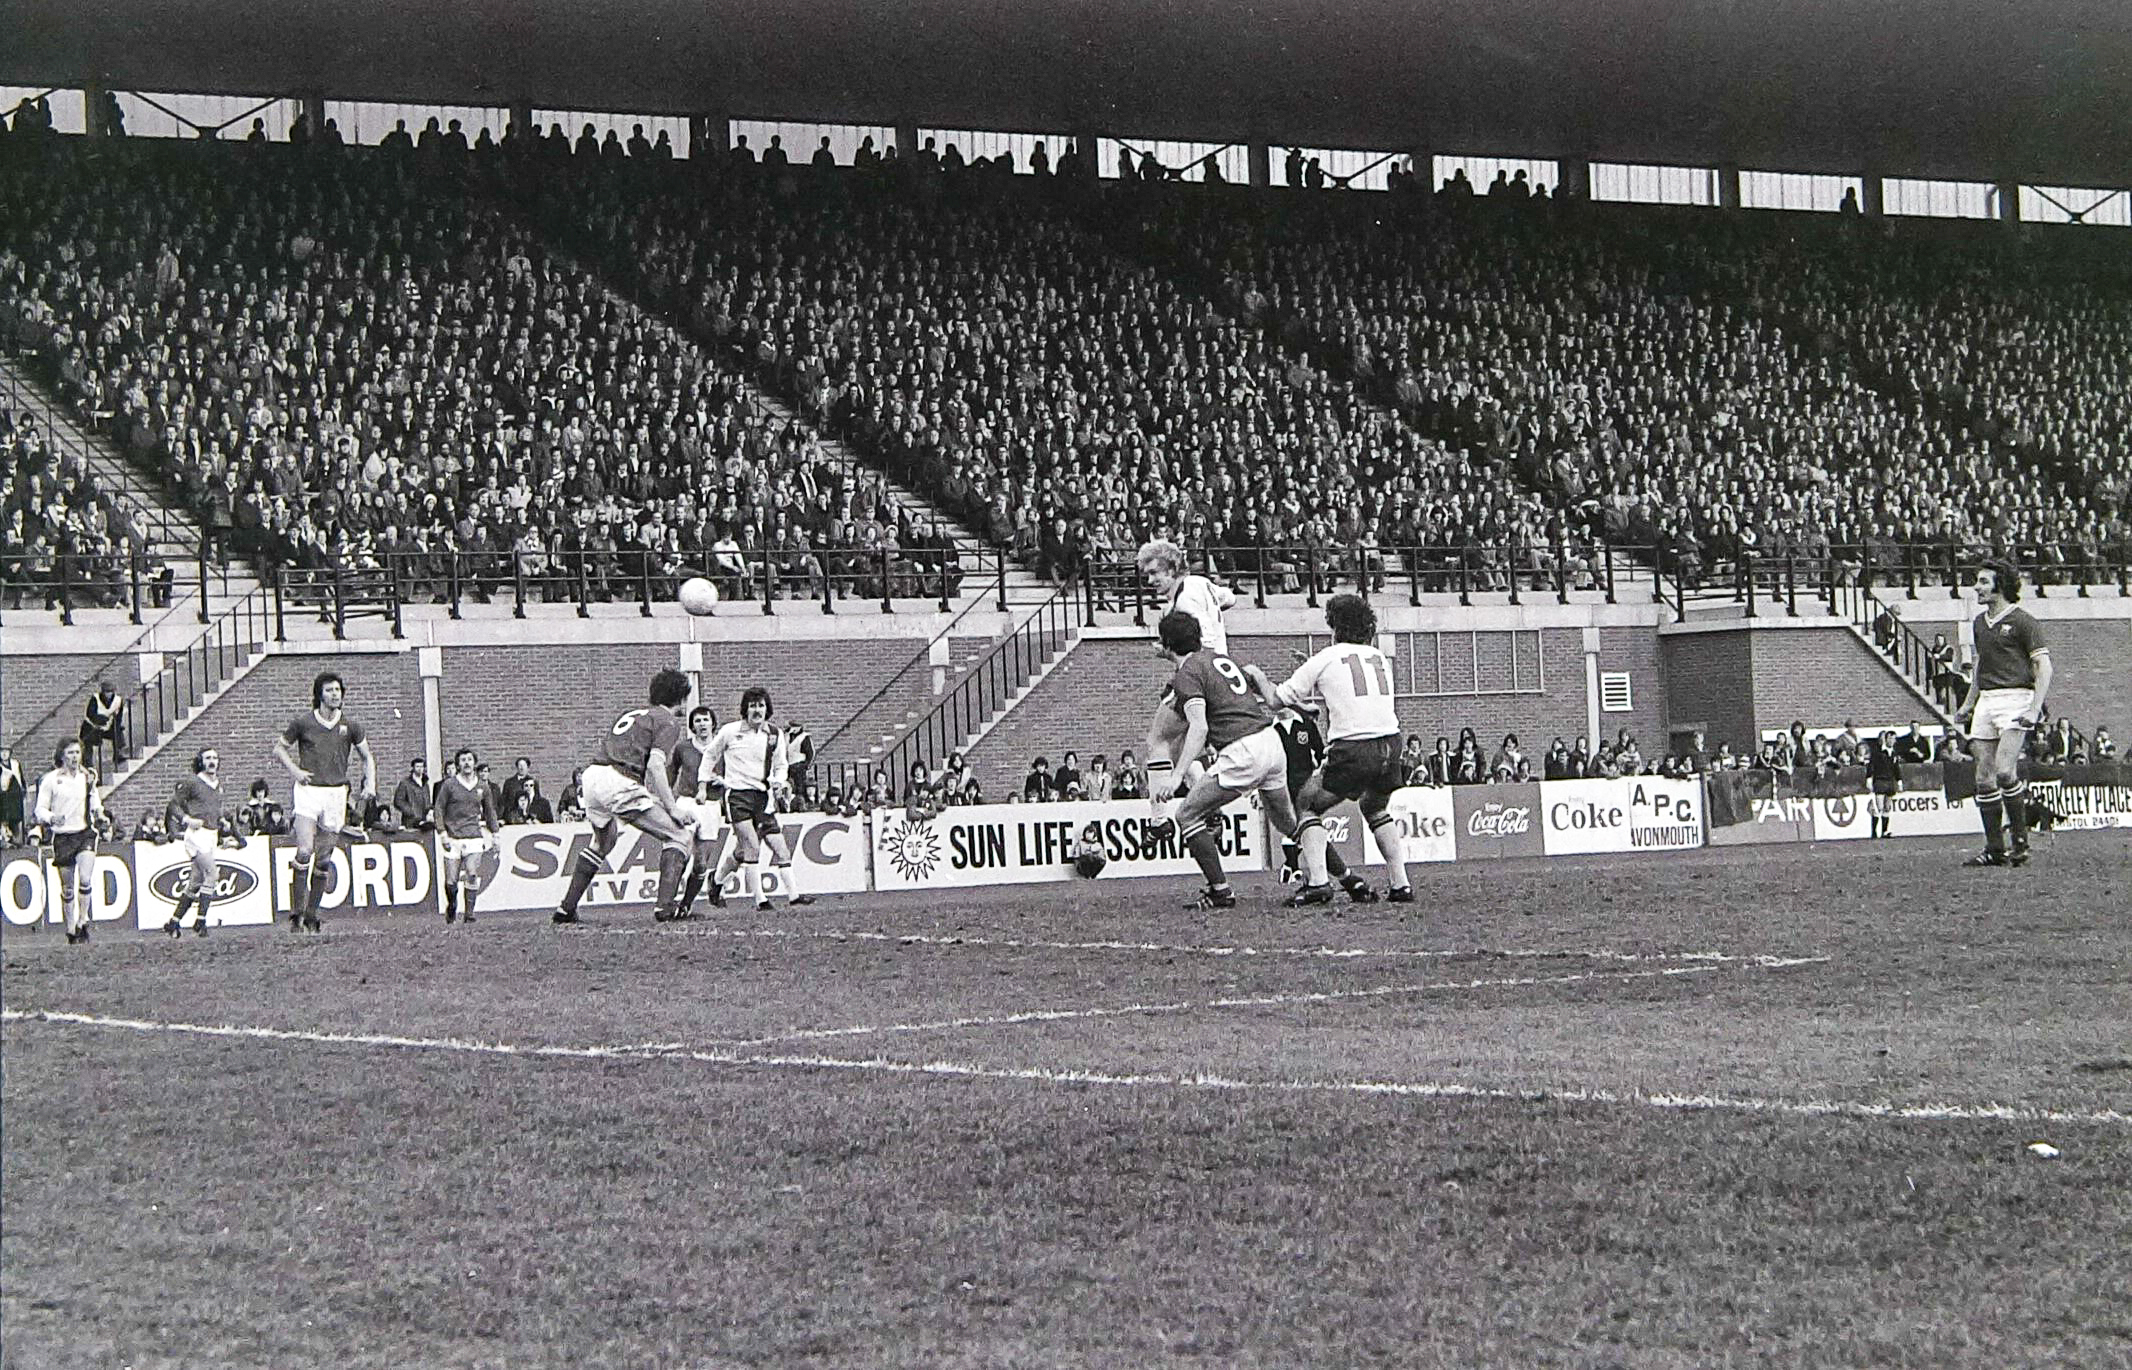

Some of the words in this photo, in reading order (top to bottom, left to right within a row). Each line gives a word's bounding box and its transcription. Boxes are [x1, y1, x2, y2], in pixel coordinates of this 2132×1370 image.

[1213, 657, 1247, 695] 9
[1341, 653, 1389, 697] 11
[613, 709, 649, 735] 6
[1751, 797, 1811, 823] AR
[1884, 796, 1939, 812] rocers
[2095, 785, 2132, 813] PLACE
[1394, 811, 1446, 838] oke
[1551, 803, 1623, 830] Coke
[950, 824, 1006, 869] SUN
[1018, 821, 1076, 867] LIFE
[1631, 826, 1699, 846] AVONMOUTH
